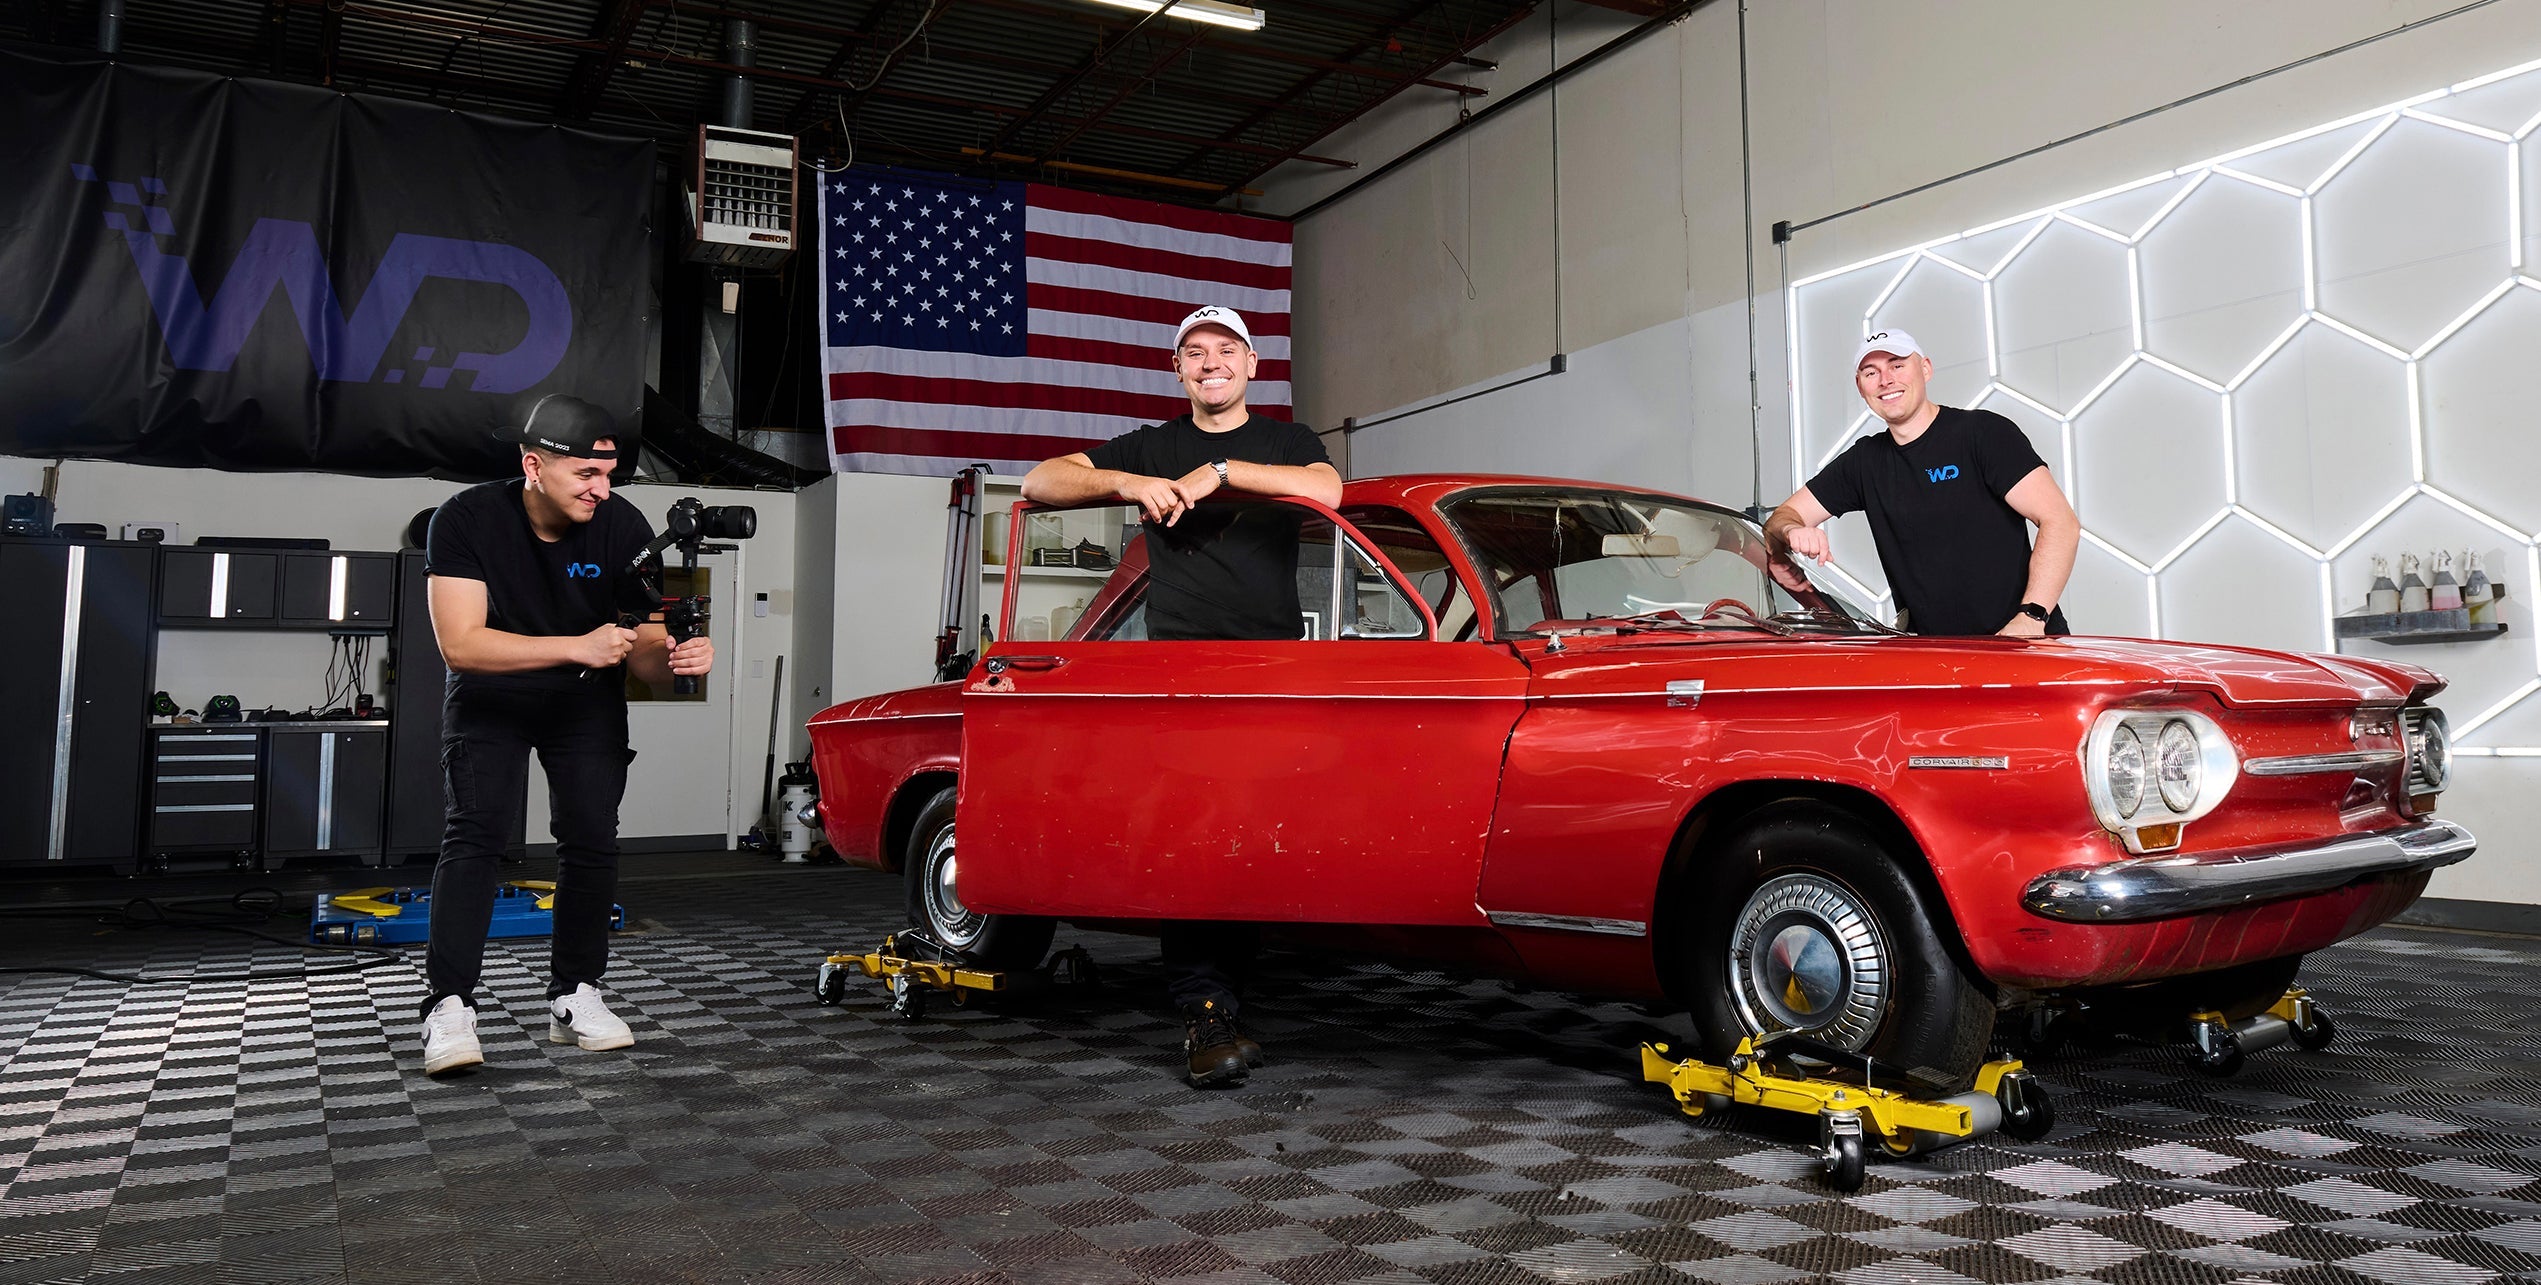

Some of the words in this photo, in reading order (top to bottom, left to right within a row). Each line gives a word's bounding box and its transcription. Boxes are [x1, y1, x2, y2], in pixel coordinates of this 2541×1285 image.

[72, 163, 573, 394] WD
[1925, 464, 1960, 483] WD
[632, 548, 651, 568] RONIN
[567, 562, 602, 579] WD
[1912, 758, 1970, 766] CORVAIR
